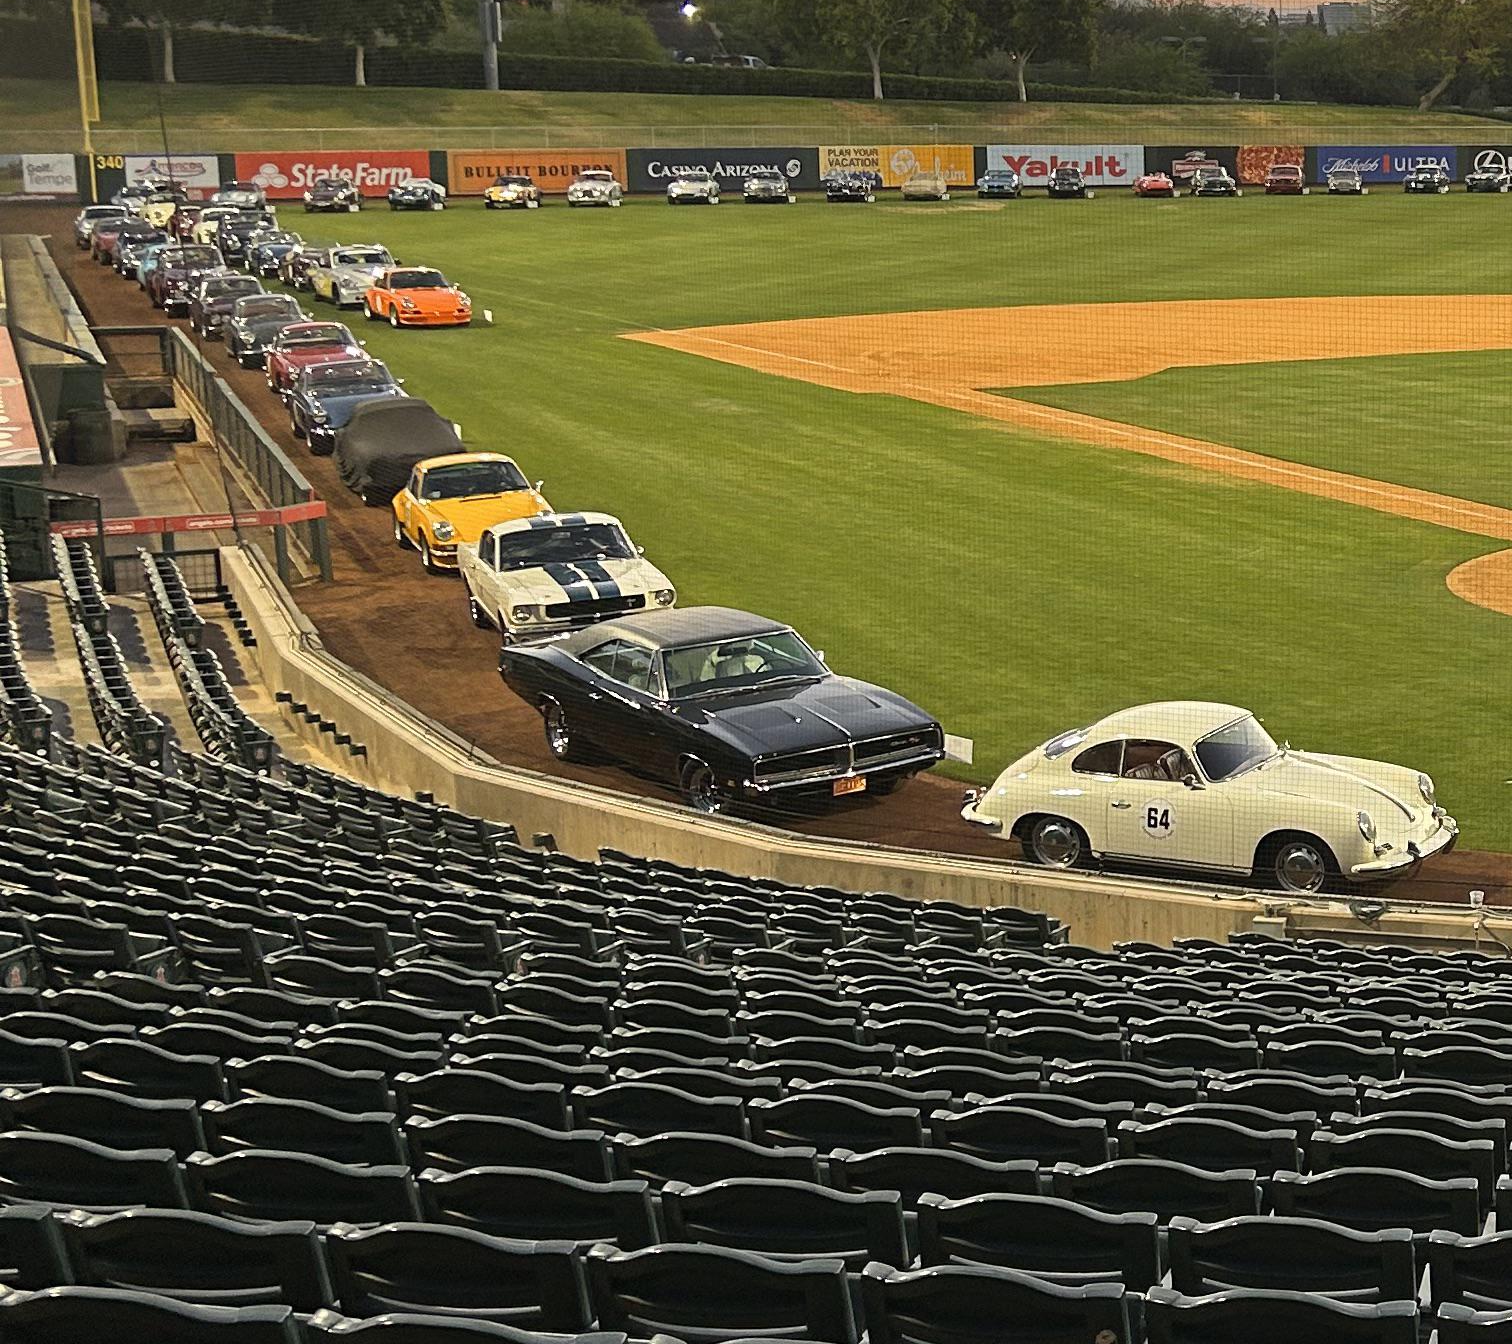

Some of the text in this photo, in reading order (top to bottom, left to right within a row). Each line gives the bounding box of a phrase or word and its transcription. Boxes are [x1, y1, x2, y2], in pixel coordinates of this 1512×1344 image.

[853, 148, 878, 156] YOUR
[96, 156, 124, 169] 340
[827, 157, 879, 167] VACATION
[1003, 155, 1127, 177] Yakult
[1395, 157, 1450, 172] ULTRA
[464, 165, 531, 178] BULLEIT
[28, 173, 73, 186] Tempe
[1147, 807, 1170, 830] 64
